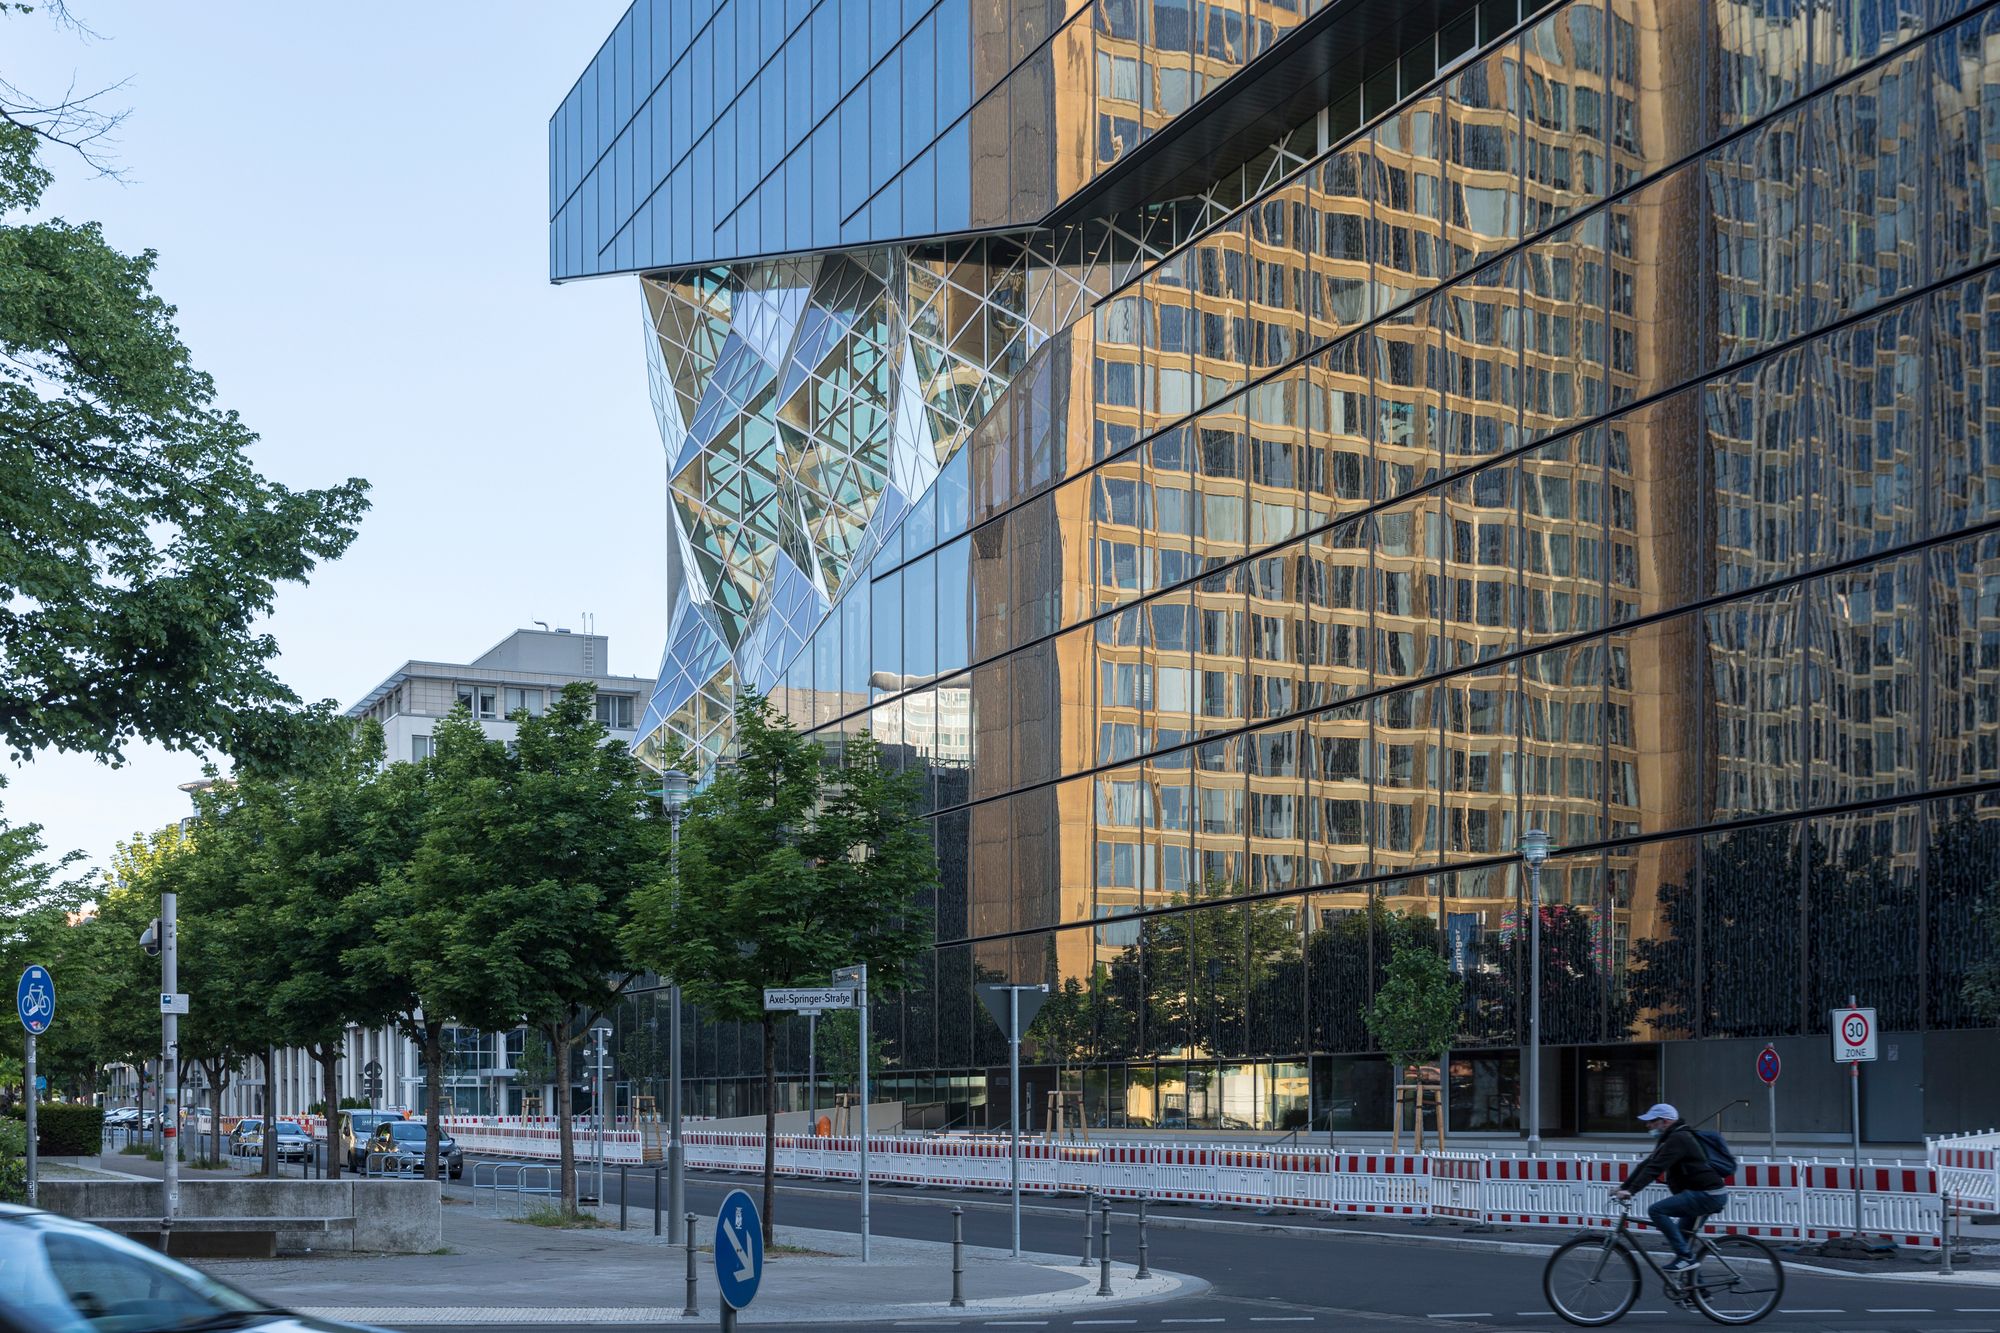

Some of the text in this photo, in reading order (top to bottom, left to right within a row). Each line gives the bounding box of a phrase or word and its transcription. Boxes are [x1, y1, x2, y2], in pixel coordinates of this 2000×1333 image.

[769, 992, 850, 1005] Axel-Springer-Straße
[1847, 1022, 1864, 1038] 30
[1846, 1048, 1867, 1058] ZONE
